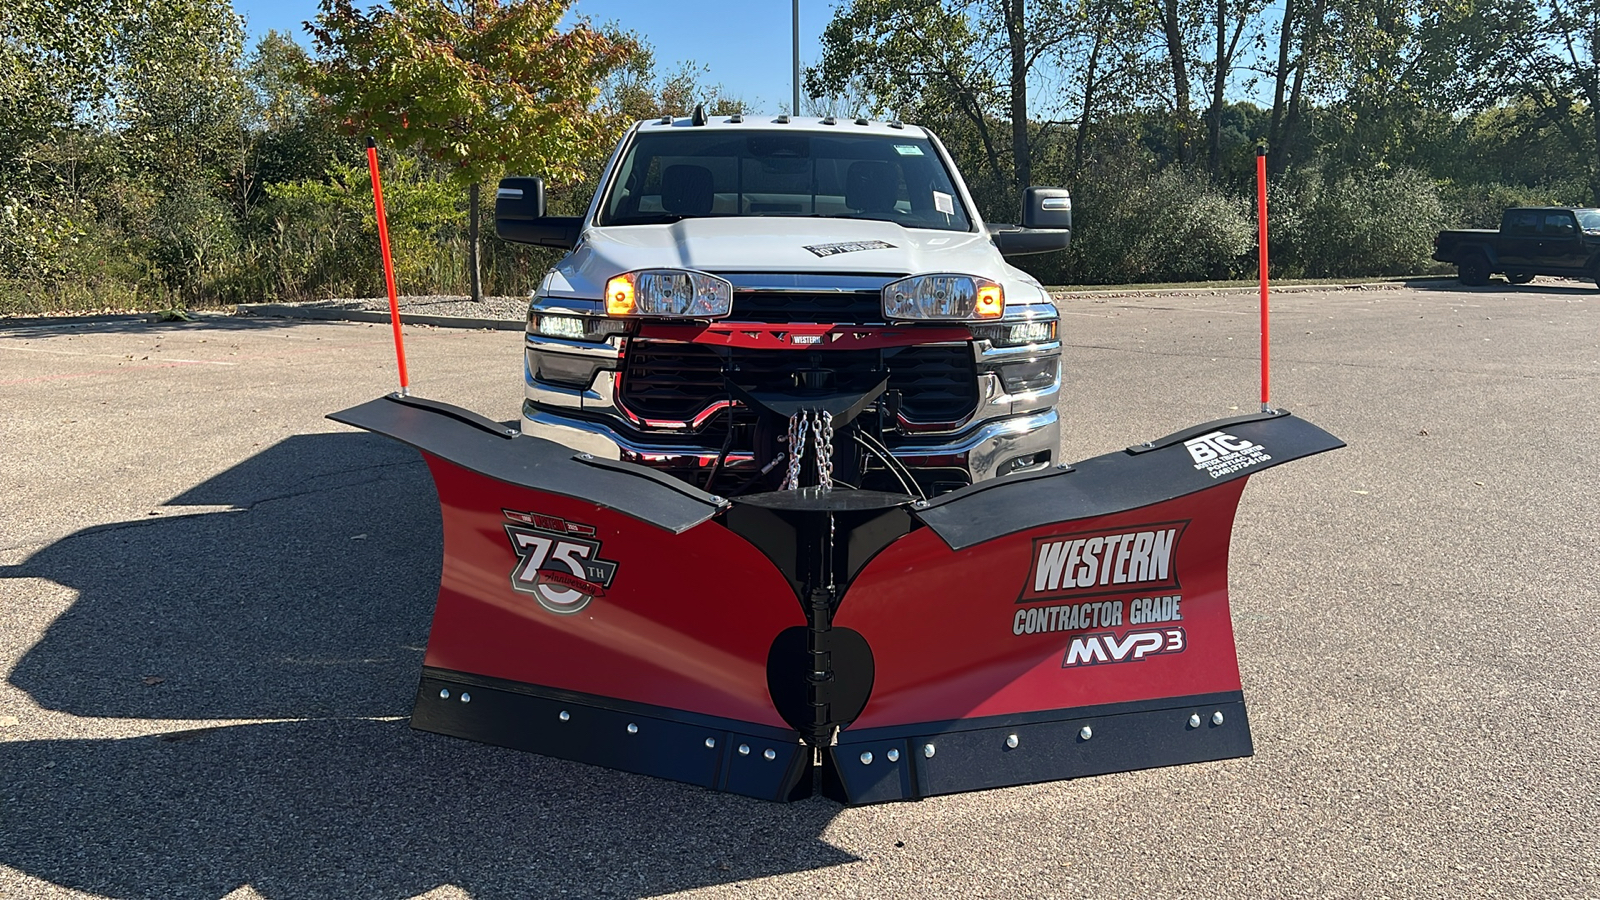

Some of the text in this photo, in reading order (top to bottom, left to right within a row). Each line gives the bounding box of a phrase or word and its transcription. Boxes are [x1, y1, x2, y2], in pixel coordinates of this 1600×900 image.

[793, 335, 821, 344] WESTERN
[1183, 431, 1254, 464] BTC
[1219, 452, 1239, 462] TRUCK
[1240, 445, 1265, 455] CENTER
[515, 533, 605, 603] 75 TH
[1034, 529, 1176, 592] WESTERN
[544, 571, 597, 596] Anniversary
[1012, 595, 1182, 636] CONTRACTOR GRADE
